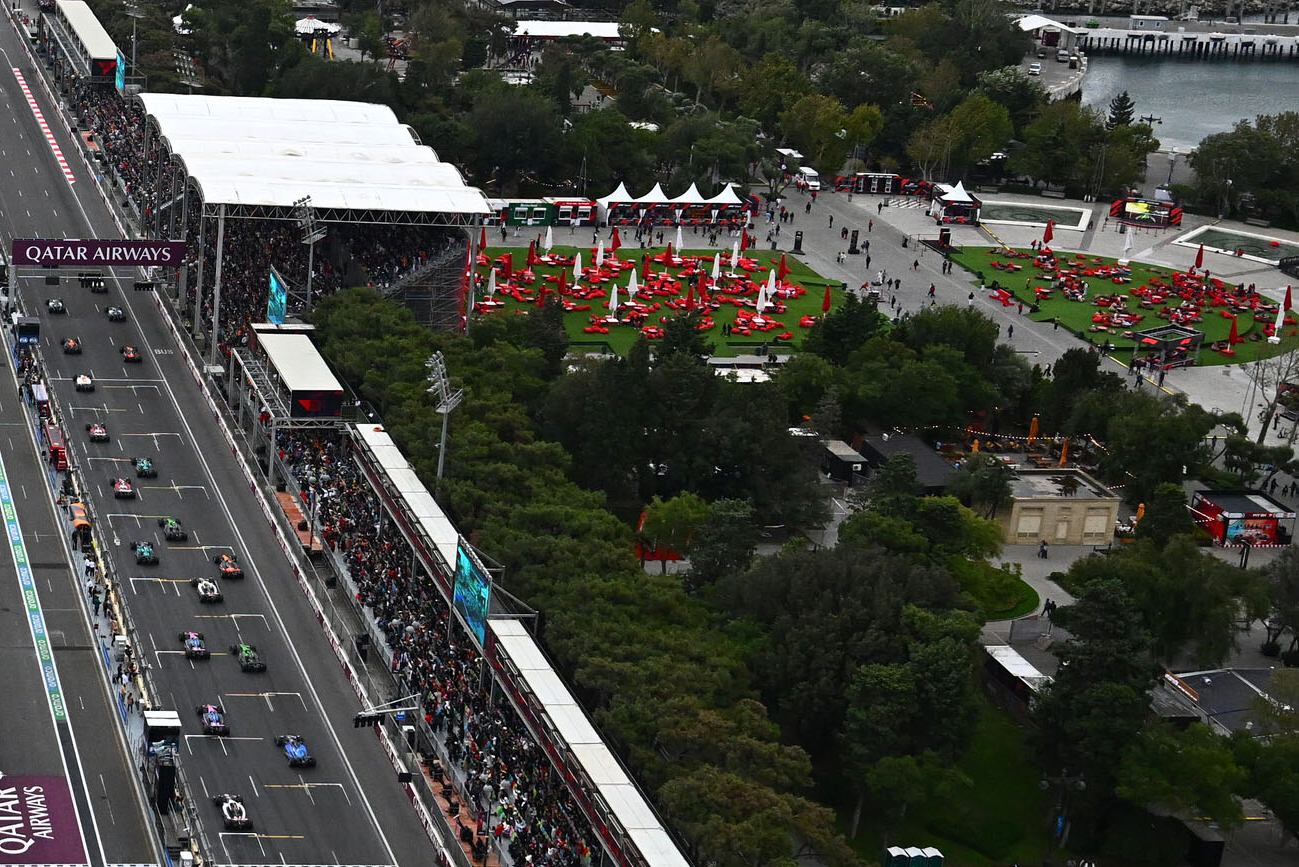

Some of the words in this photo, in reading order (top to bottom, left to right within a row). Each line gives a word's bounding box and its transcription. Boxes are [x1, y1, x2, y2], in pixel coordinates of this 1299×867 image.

[26, 246, 88, 263] QATAR
[93, 247, 171, 261] AIRWAYS
[25, 590, 37, 609] aramco
[31, 614, 43, 634] aramco
[38, 639, 50, 660] aramco
[44, 666, 57, 687] aramco
[51, 694, 64, 716] aramco
[23, 786, 54, 839] AIRWAYS
